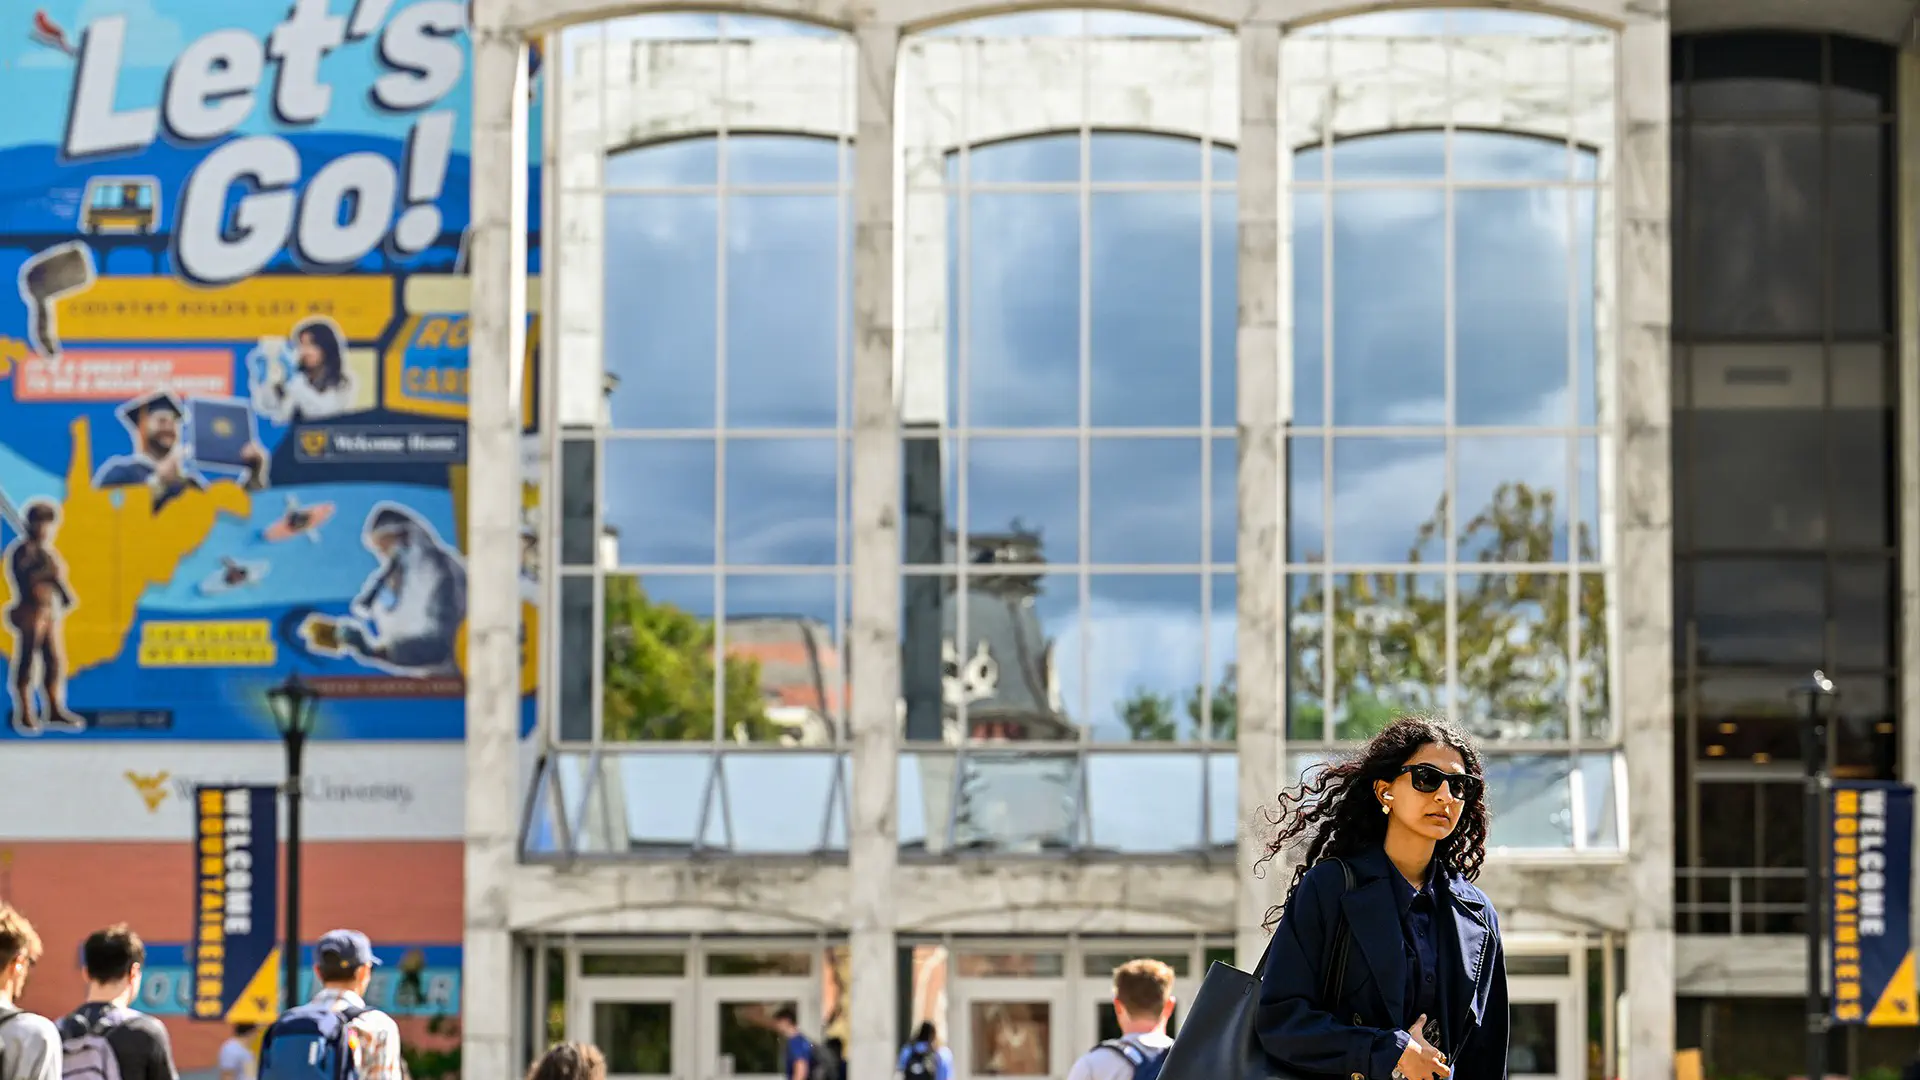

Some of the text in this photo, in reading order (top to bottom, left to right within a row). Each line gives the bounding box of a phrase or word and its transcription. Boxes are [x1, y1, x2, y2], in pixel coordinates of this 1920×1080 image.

[66, 0, 464, 158] Let's
[178, 110, 456, 284] Go!
[196, 789, 224, 1018] MOUNTAINEERS
[224, 788, 252, 935] WELCOME
[1834, 790, 1861, 1021] MOUNTAINEERS
[1860, 790, 1887, 935] WELCOME
